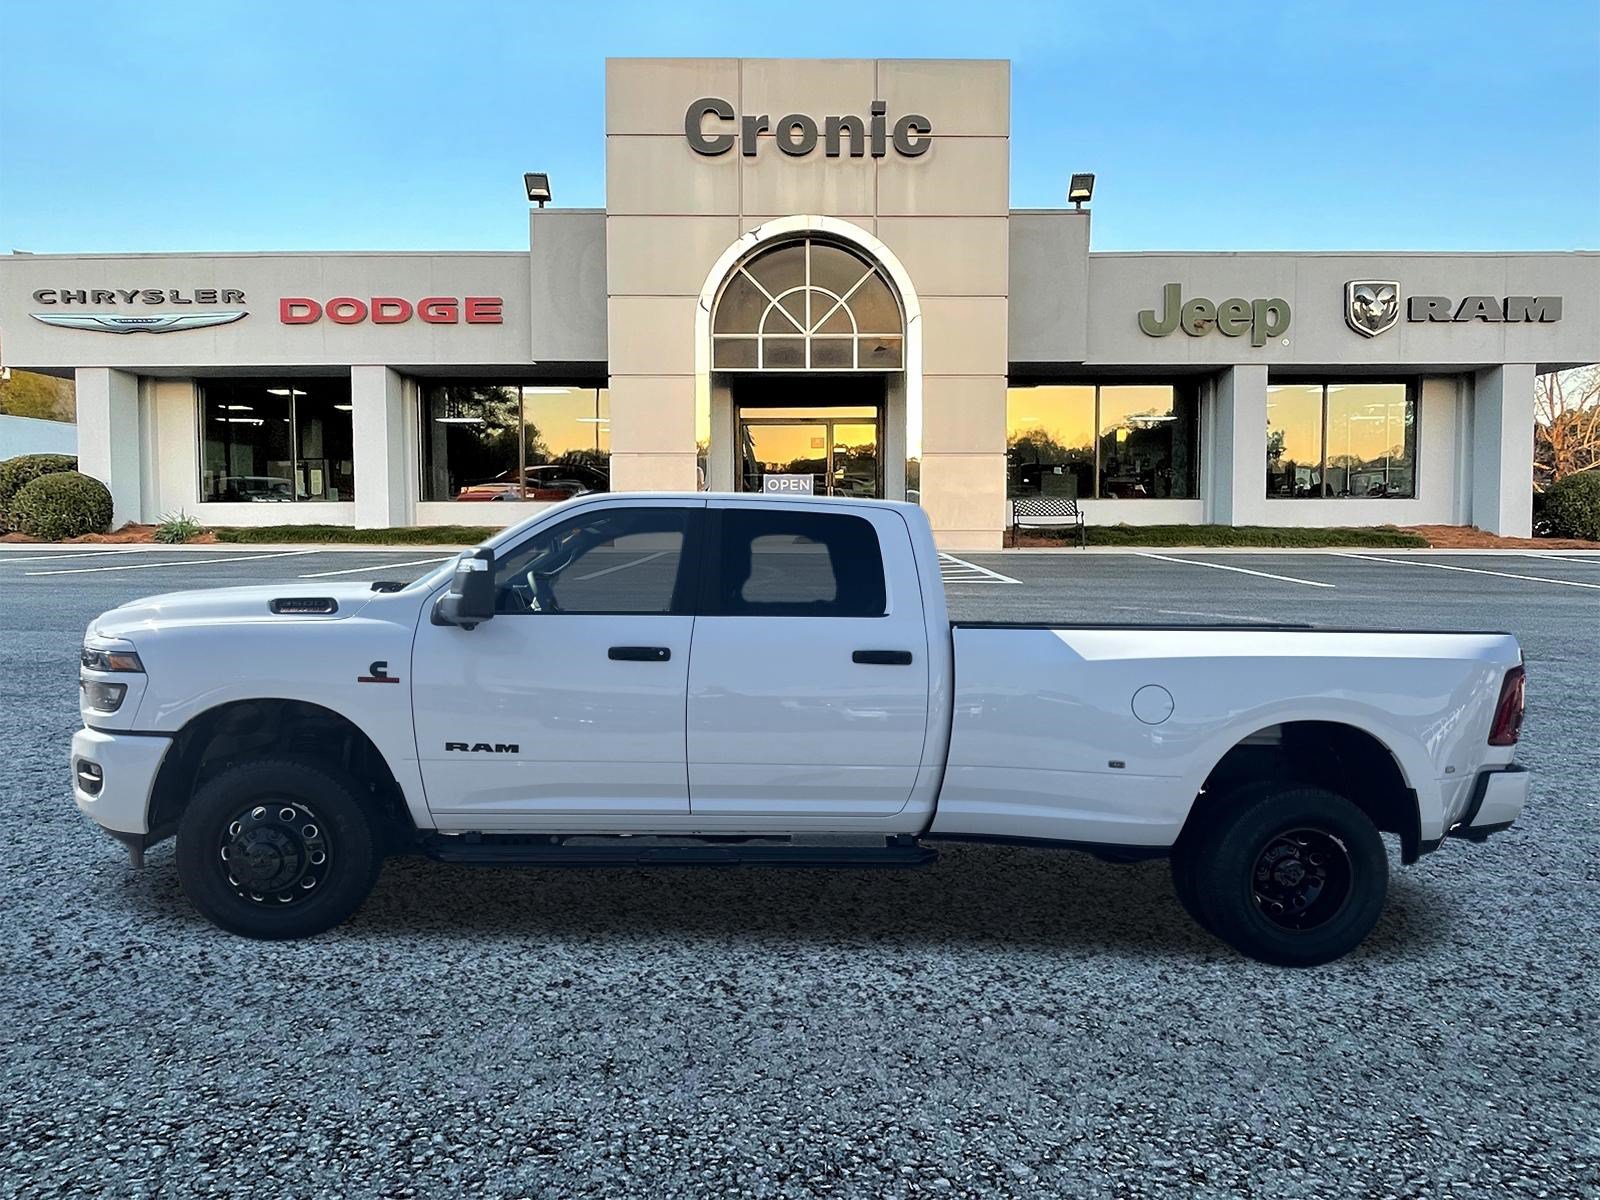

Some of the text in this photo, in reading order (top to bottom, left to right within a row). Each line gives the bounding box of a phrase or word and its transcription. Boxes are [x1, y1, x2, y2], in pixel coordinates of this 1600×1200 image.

[685, 97, 932, 157] Cronic
[32, 289, 246, 304] CHRYSLER
[1407, 296, 1562, 322] RAM
[280, 297, 504, 324] DODGE
[1138, 283, 1291, 347] Jeep
[767, 479, 810, 491] OPEN
[445, 742, 519, 753] RAM
